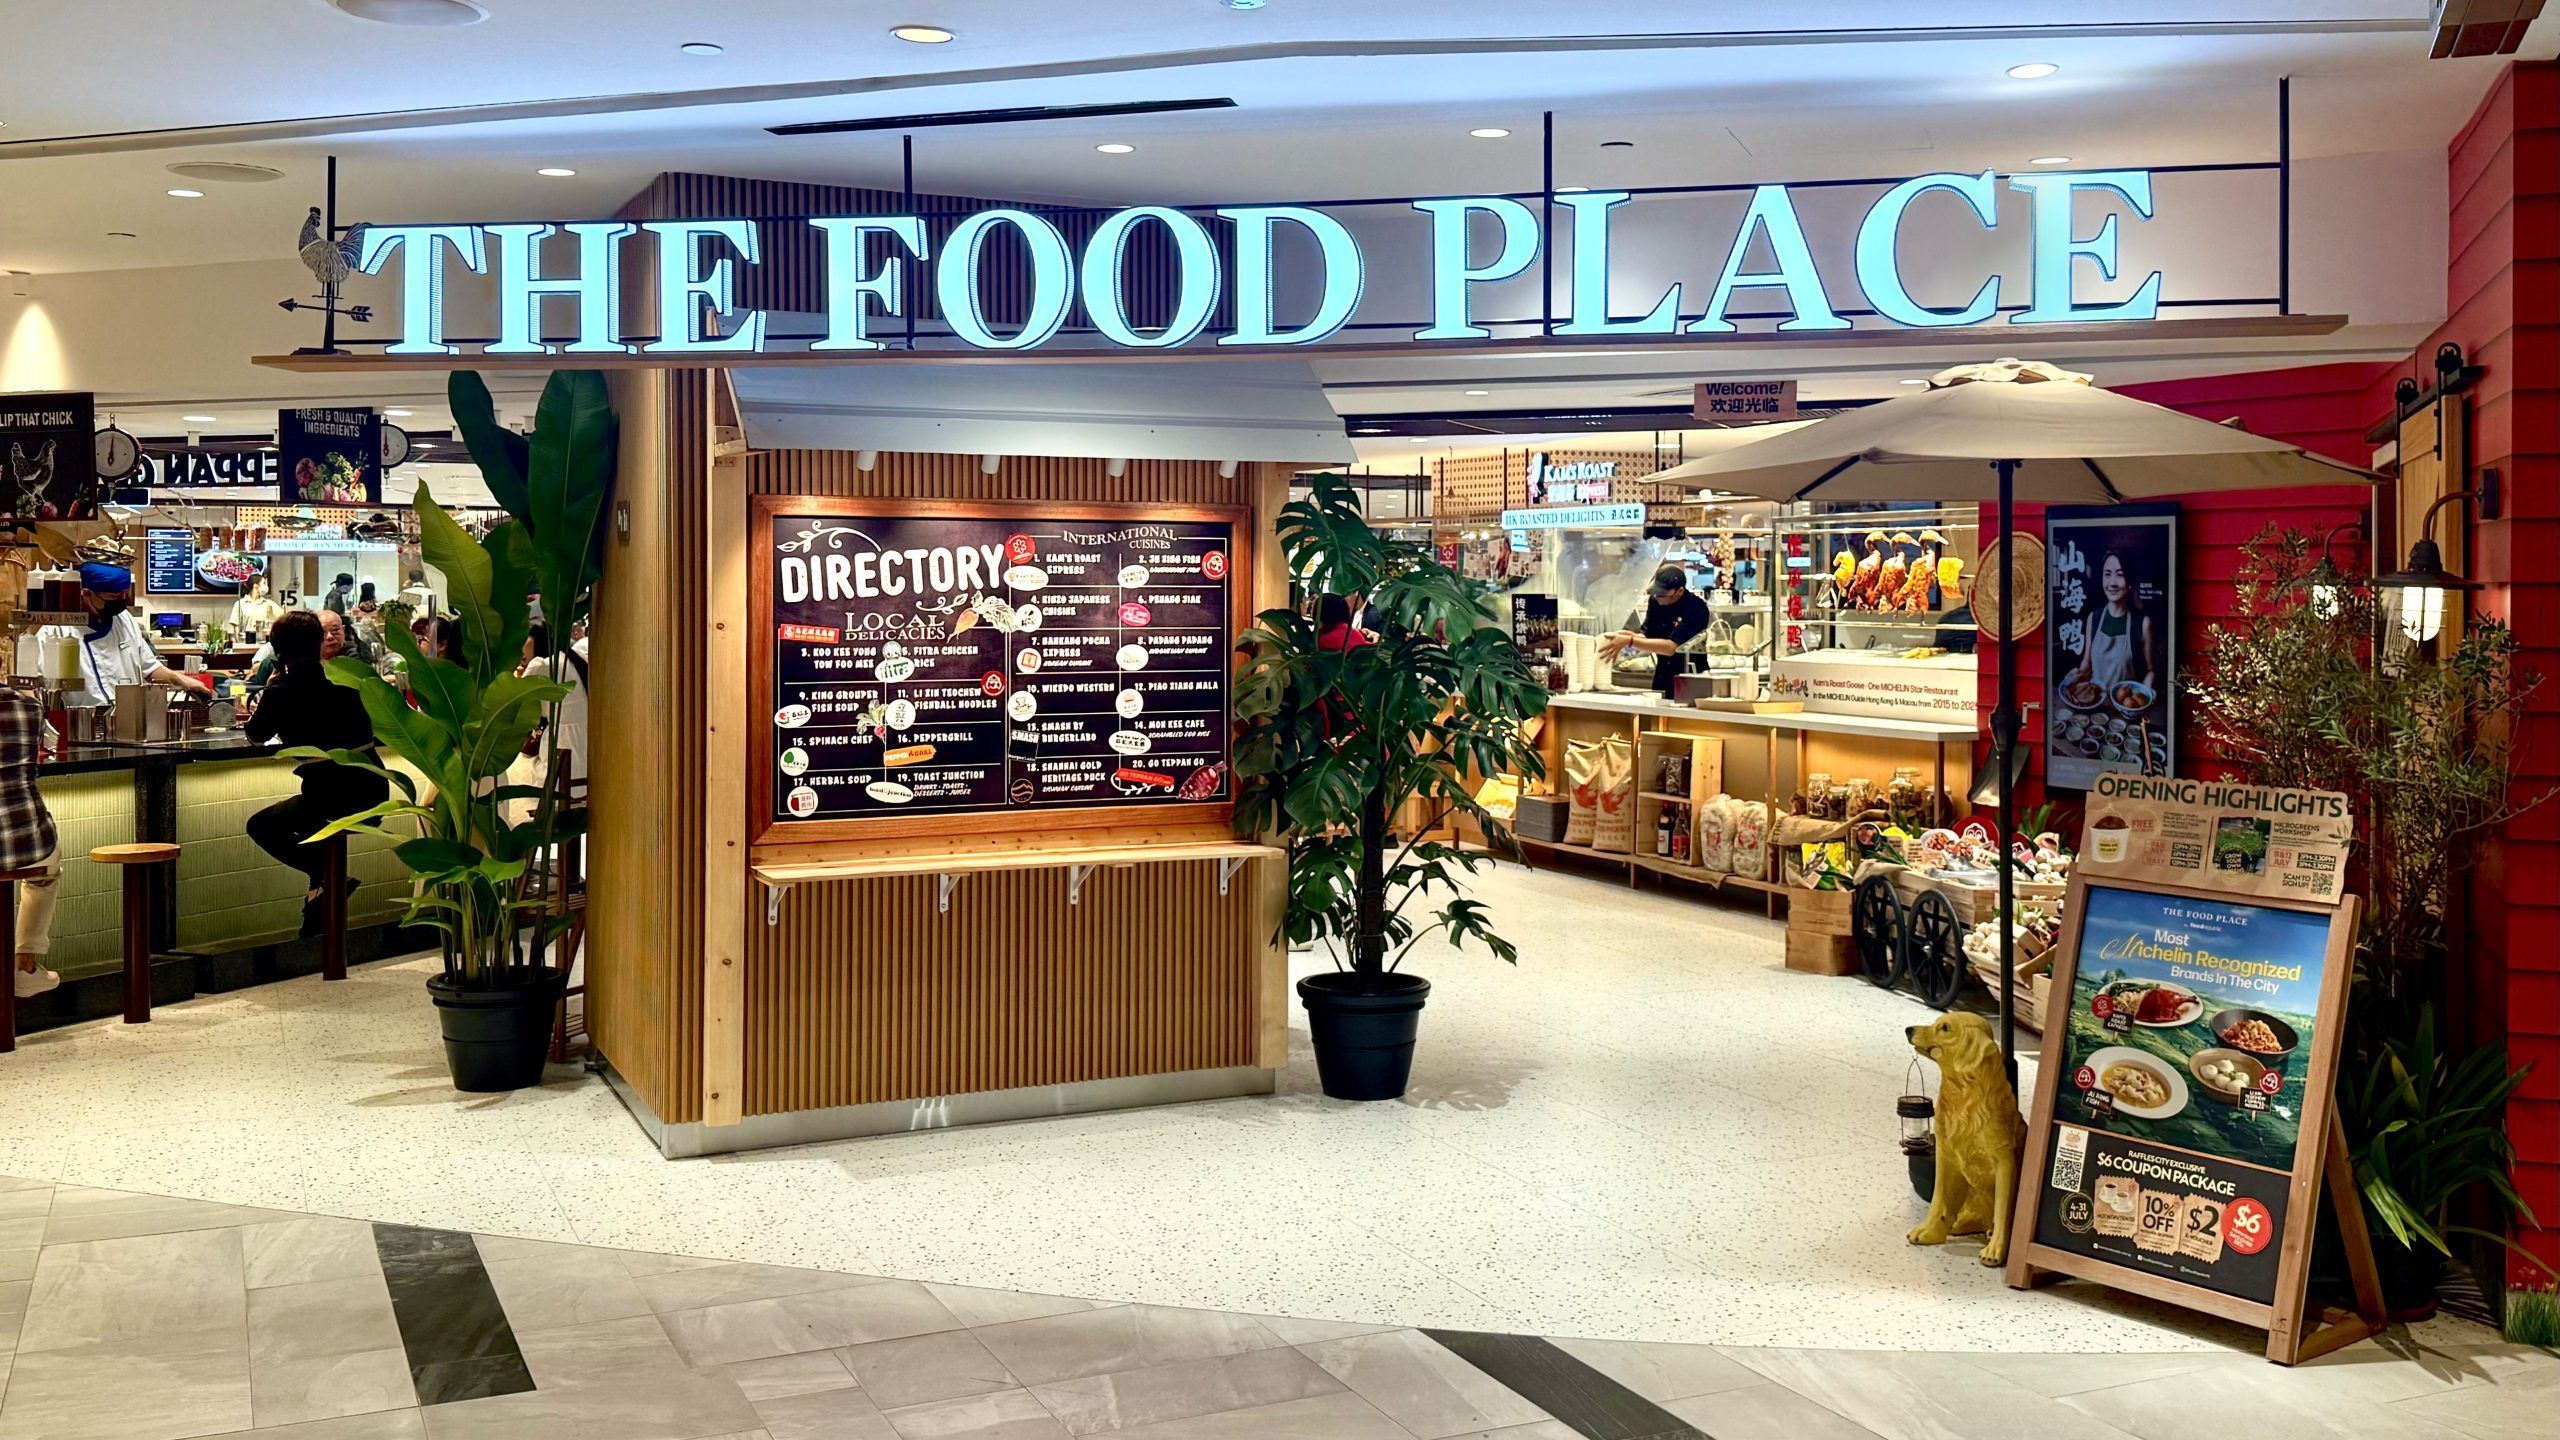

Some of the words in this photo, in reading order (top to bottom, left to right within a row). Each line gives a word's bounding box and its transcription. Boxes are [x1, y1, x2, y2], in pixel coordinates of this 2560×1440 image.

[359, 220, 768, 355] THE
[808, 206, 1367, 352] FOOD
[1411, 168, 2163, 343] PLACE
[1706, 381, 1785, 396] Welcome!
[1710, 398, 1780, 413] 欢迎光临
[15, 412, 40, 426] THAT
[42, 411, 74, 425] CHICK
[296, 408, 324, 421] FRESH
[325, 410, 331, 421] &
[333, 411, 368, 425] QUALITY
[304, 421, 360, 437] INGREDIENTS
[1577, 461, 1617, 481] ROAST
[1505, 514, 1518, 526] HK
[1519, 512, 1558, 526] ROASTED
[1560, 510, 1606, 525] DELIGHTS
[1063, 526, 1178, 546] INTERNATIONAL
[1129, 539, 1171, 549] CUISINES
[1046, 553, 1073, 563] KAM'S
[1074, 553, 1102, 563] ROAST
[781, 543, 1004, 603] DIRECTORY
[1046, 565, 1085, 575] EXPRESS
[278, 589, 298, 607] 15
[1068, 594, 1111, 604] JAPANESE
[1149, 594, 1181, 604] PENANG
[1042, 606, 1076, 616] CUISINE
[845, 612, 945, 632] LOCAL
[845, 627, 946, 641] DELICACIES
[1031, 637, 1040, 646] 7.
[1082, 636, 1111, 645] POCHA
[1148, 635, 1180, 645] PADANG
[1181, 635, 1213, 645] PADANG
[813, 647, 831, 657] KOO
[833, 647, 851, 657] KEE
[853, 646, 877, 657] YONG
[913, 646, 939, 656] FITRA
[941, 645, 979, 655] CHICKEN
[1042, 648, 1081, 657] EXPRESS
[813, 659, 833, 669] TOW
[835, 659, 853, 669] FOO
[855, 659, 874, 669] MEE
[914, 658, 936, 668] RICE
[1026, 684, 1040, 693] 10.
[1041, 683, 1075, 693] WIKEDO
[1076, 683, 1115, 692] WESTERN
[1134, 682, 1147, 691] 12.
[1148, 682, 1168, 691] PIAO
[1169, 681, 1194, 691] XIANG
[1195, 681, 1219, 690] MALA
[1813, 679, 1829, 688] Kam's
[1829, 679, 1848, 689] Roast
[1848, 680, 1865, 690] Goose
[1868, 682, 1880, 691] One
[1880, 682, 1910, 693] MICHELIN
[1910, 685, 1923, 694] Star
[1923, 685, 1959, 696] Restaurant
[799, 691, 809, 700] 9.
[811, 690, 834, 700] KING
[835, 689, 879, 700] GROUPER
[897, 689, 909, 698] 11.
[913, 689, 923, 698] LI
[941, 687, 982, 698] TEOCHEW
[914, 700, 957, 710] FISHBALL
[958, 699, 998, 709] NOODLES
[1826, 692, 1850, 701] MICHELIN
[1850, 694, 1866, 703] Guide
[1866, 696, 1880, 705] Hong
[1880, 697, 1894, 706] Kong
[1899, 698, 1917, 707] Macau
[1918, 699, 1932, 708] from
[1932, 699, 1951, 709] 2015
[1951, 701, 1960, 710] to
[811, 703, 833, 713] FISH
[835, 702, 860, 712] SOUP
[1041, 721, 1071, 731] SMASH
[1072, 721, 1084, 731] BY
[1134, 721, 1147, 729] 14.
[1148, 720, 1166, 729] MON
[1167, 719, 1183, 729] KEE
[1184, 719, 1205, 728] CAFE
[792, 737, 807, 746] 15.
[809, 736, 848, 746] SPINACH
[850, 734, 873, 745] CHEF
[898, 734, 911, 743] 16.
[913, 732, 974, 743] PEPPERGRILL
[1011, 730, 1039, 743] SMASH
[1041, 733, 1097, 743] BURGERLABO
[1148, 731, 1184, 739] SCRAMBLED
[1041, 762, 1078, 771] SHANHAI
[1080, 761, 1102, 770] GOLD
[1132, 759, 1146, 768] 20.
[1148, 759, 1160, 768] GO
[1161, 758, 1192, 768] TEPPAN
[1193, 758, 1205, 767] GO
[793, 777, 807, 787] 17.
[810, 775, 845, 786] HERBAL
[847, 774, 872, 785] SOUP
[897, 773, 911, 782] 19.
[913, 771, 941, 781] TOAST
[942, 770, 985, 781] JUNCTION
[1041, 773, 1082, 783] HERITAGE
[1083, 772, 1106, 782] DUCK
[2098, 776, 2197, 804] OPENING
[2203, 785, 2343, 818] HIGHLIGHTS
[2131, 819, 2154, 829] FREE
[2274, 822, 2320, 832] MICROGREENS
[2273, 828, 2311, 837] WORKSHOP
[2273, 858, 2290, 866] JULY
[2283, 872, 2301, 881] SCAN
[2302, 874, 2311, 882] TO
[2282, 879, 2298, 887] SIGN
[2162, 907, 2183, 918] THE
[2186, 910, 2213, 921] FOOD
[2216, 914, 2248, 927] PLACE
[2154, 929, 2190, 947] Most
[2100, 932, 2193, 965] Michelin
[2196, 950, 2302, 982] Recognized
[2171, 965, 2214, 983] Brands
[2215, 971, 2227, 985] In
[2228, 973, 2252, 989] The
[2253, 977, 2280, 995] City
[2128, 1150, 2155, 1163] RAFFLES
[2155, 1155, 2170, 1166] CITY
[2170, 1159, 2206, 1174] EXCLUSIVE
[2097, 1152, 2113, 1167] $6
[2113, 1156, 2172, 1181] COUPON
[2173, 1170, 2237, 1197] PACKAGE
[2070, 1202, 2087, 1211] 4-31
[2145, 1195, 2175, 1218] 10%
[2069, 1211, 2088, 1220] JULY
[2233, 1204, 2262, 1234] $6
[2143, 1214, 2175, 1232] OFF
[2187, 1205, 2220, 1238] $2
